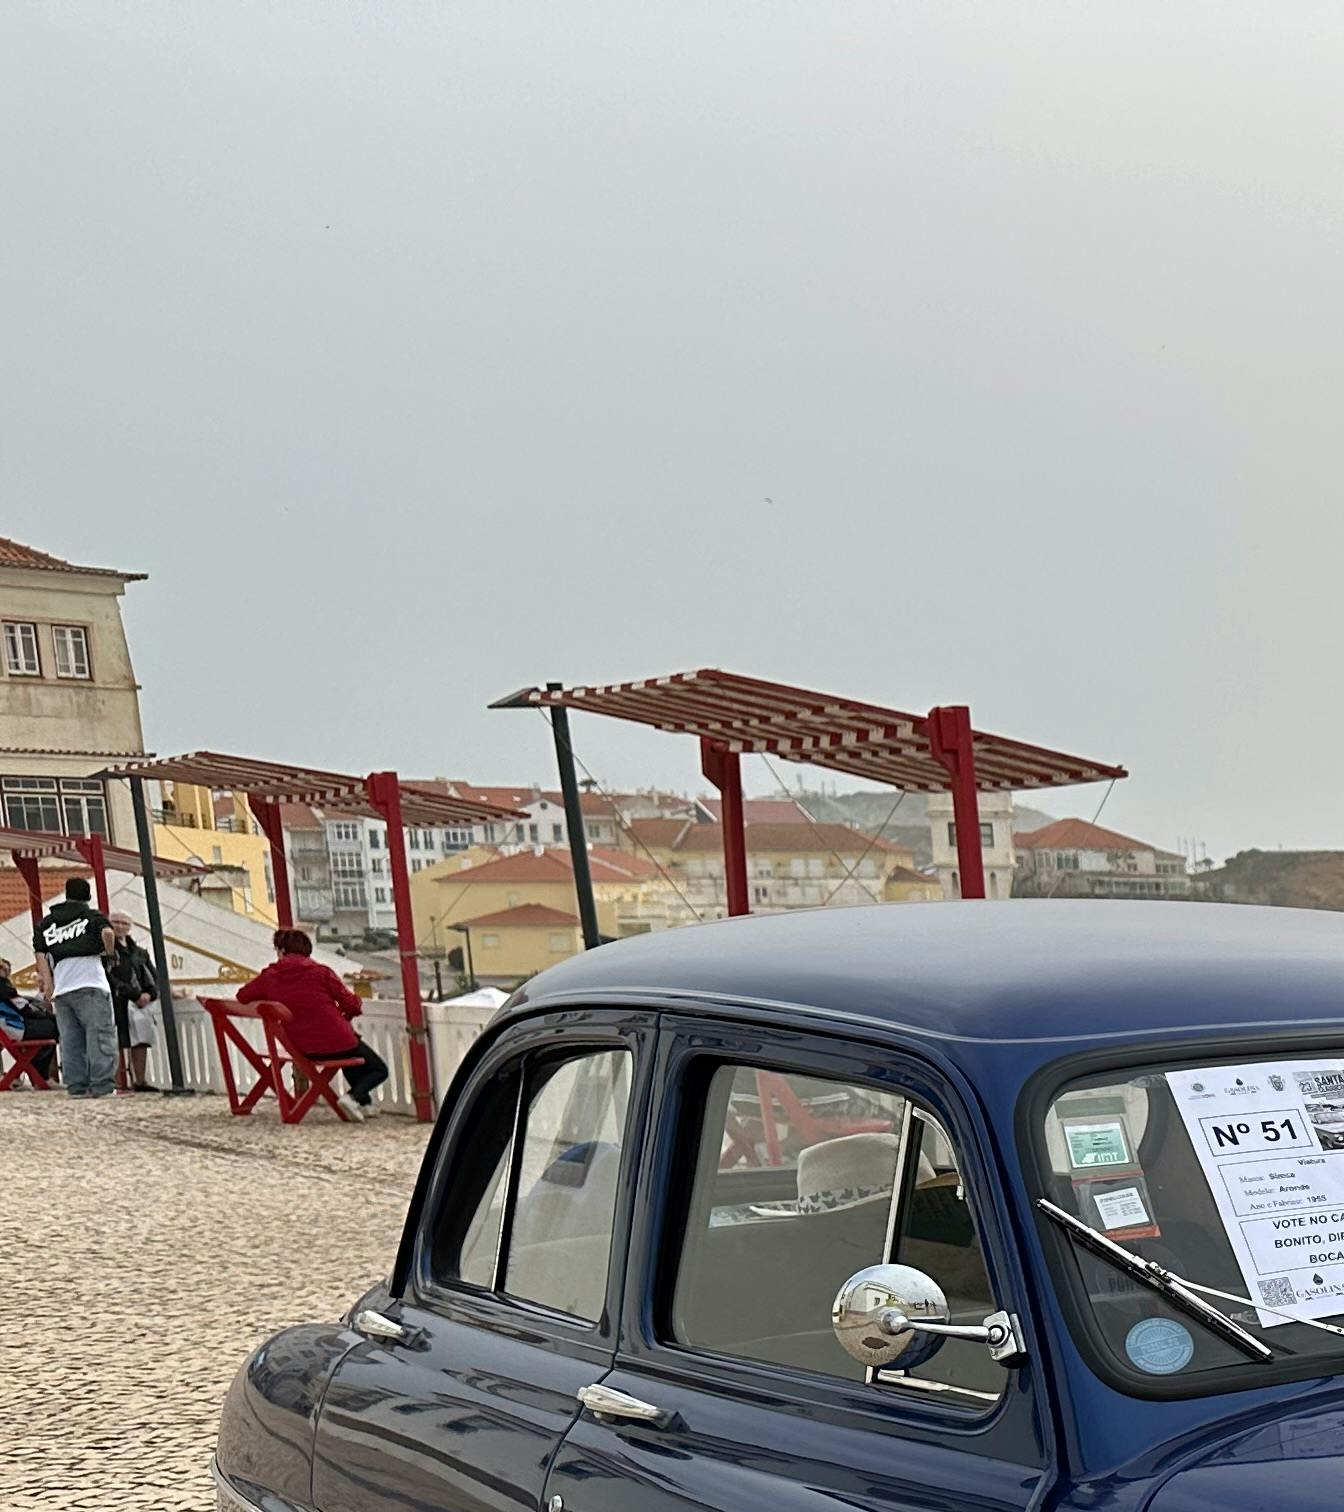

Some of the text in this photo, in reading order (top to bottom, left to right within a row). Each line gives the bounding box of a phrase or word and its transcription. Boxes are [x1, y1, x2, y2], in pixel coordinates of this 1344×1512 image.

[1211, 1118, 1298, 1148] Nº 51
[1272, 1217, 1306, 1230] VOTE
[1309, 1214, 1328, 1225] NO
[1274, 1234, 1326, 1249] BONITO,
[1309, 1252, 1344, 1264] BOCA
